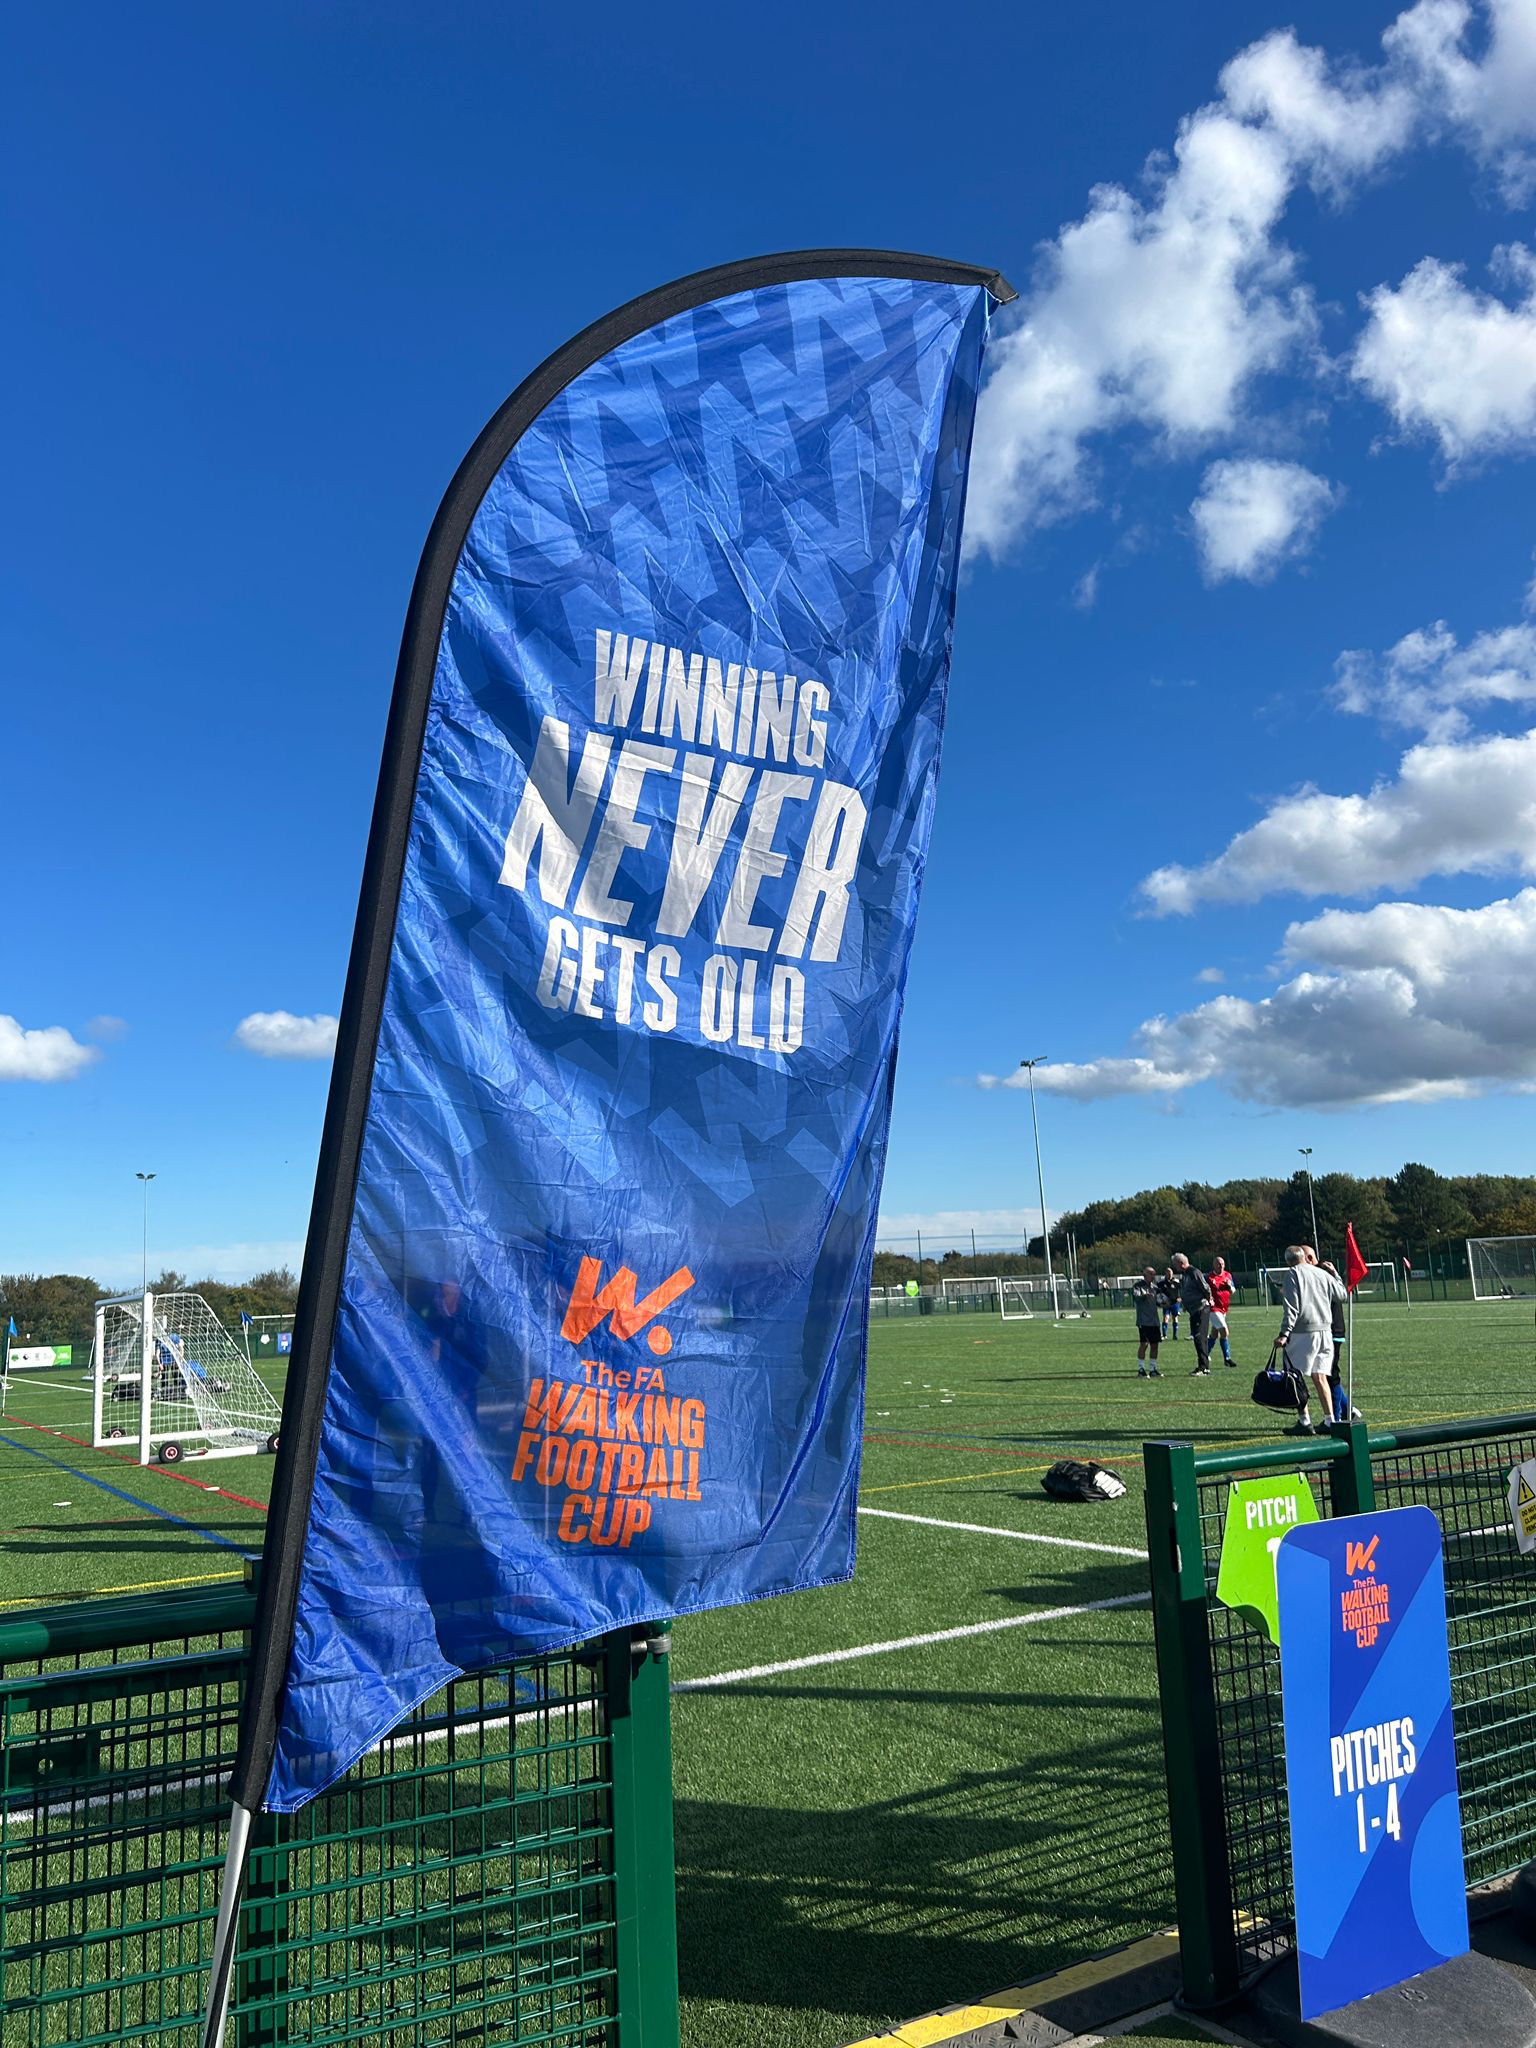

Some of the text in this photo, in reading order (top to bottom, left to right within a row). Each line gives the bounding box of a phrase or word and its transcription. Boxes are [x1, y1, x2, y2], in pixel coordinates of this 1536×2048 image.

[595, 628, 830, 768] WINNING
[498, 715, 867, 962] NEVER
[536, 915, 805, 1054] GETS OLD
[581, 1360, 665, 1392] The FA
[523, 1378, 705, 1448] WALKING
[511, 1431, 703, 1501] FOOTBALL
[558, 1494, 652, 1548] CUP
[1245, 1495, 1298, 1530] PITCH
[1341, 1583, 1389, 1611] WALKING
[1353, 1576, 1376, 1589] The FA
[1342, 1603, 1390, 1632] FOOTBALL
[1356, 1625, 1378, 1648] CUP
[1330, 1717, 1416, 1797] PITCHES
